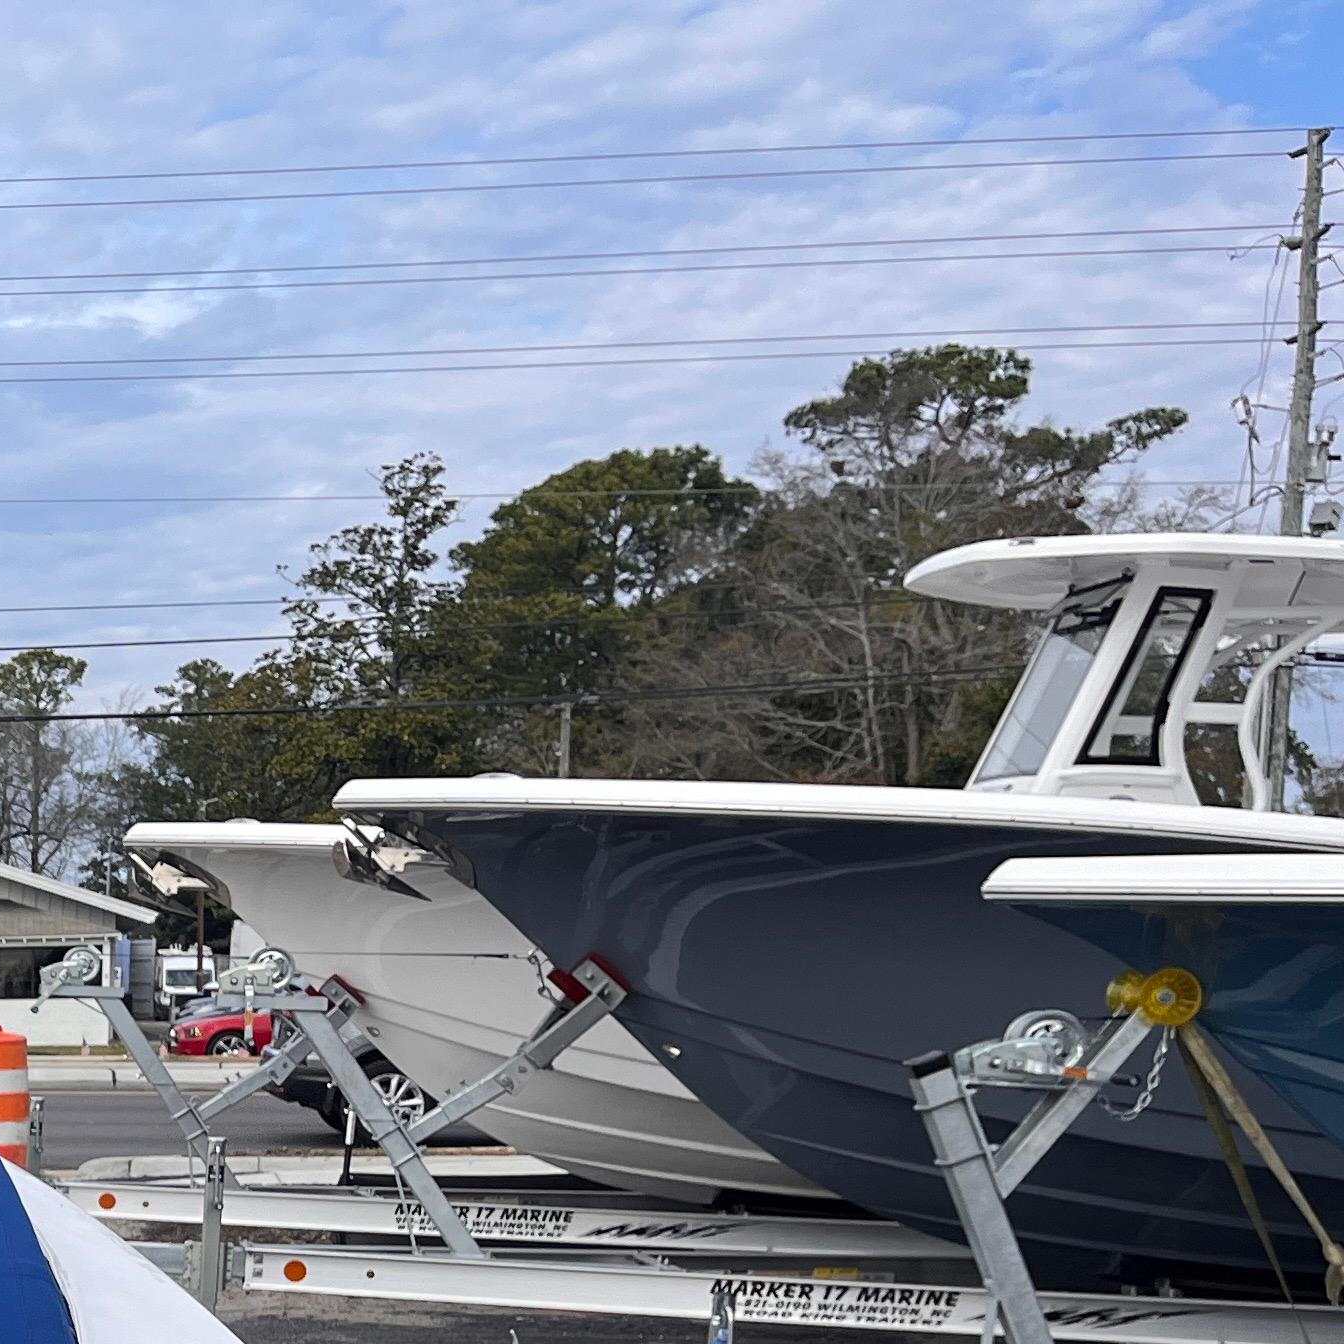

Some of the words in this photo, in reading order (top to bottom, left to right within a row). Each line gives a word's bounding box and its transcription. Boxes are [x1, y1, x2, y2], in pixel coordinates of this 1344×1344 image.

[394, 1202, 469, 1219] MAR
[476, 1206, 496, 1220] 17
[499, 1207, 575, 1224] MARINE
[552, 1224, 569, 1232] NC
[709, 1278, 814, 1300] MARKER
[823, 1285, 849, 1301] 17
[856, 1287, 962, 1307] MARINE
[930, 1308, 953, 1319] NC
